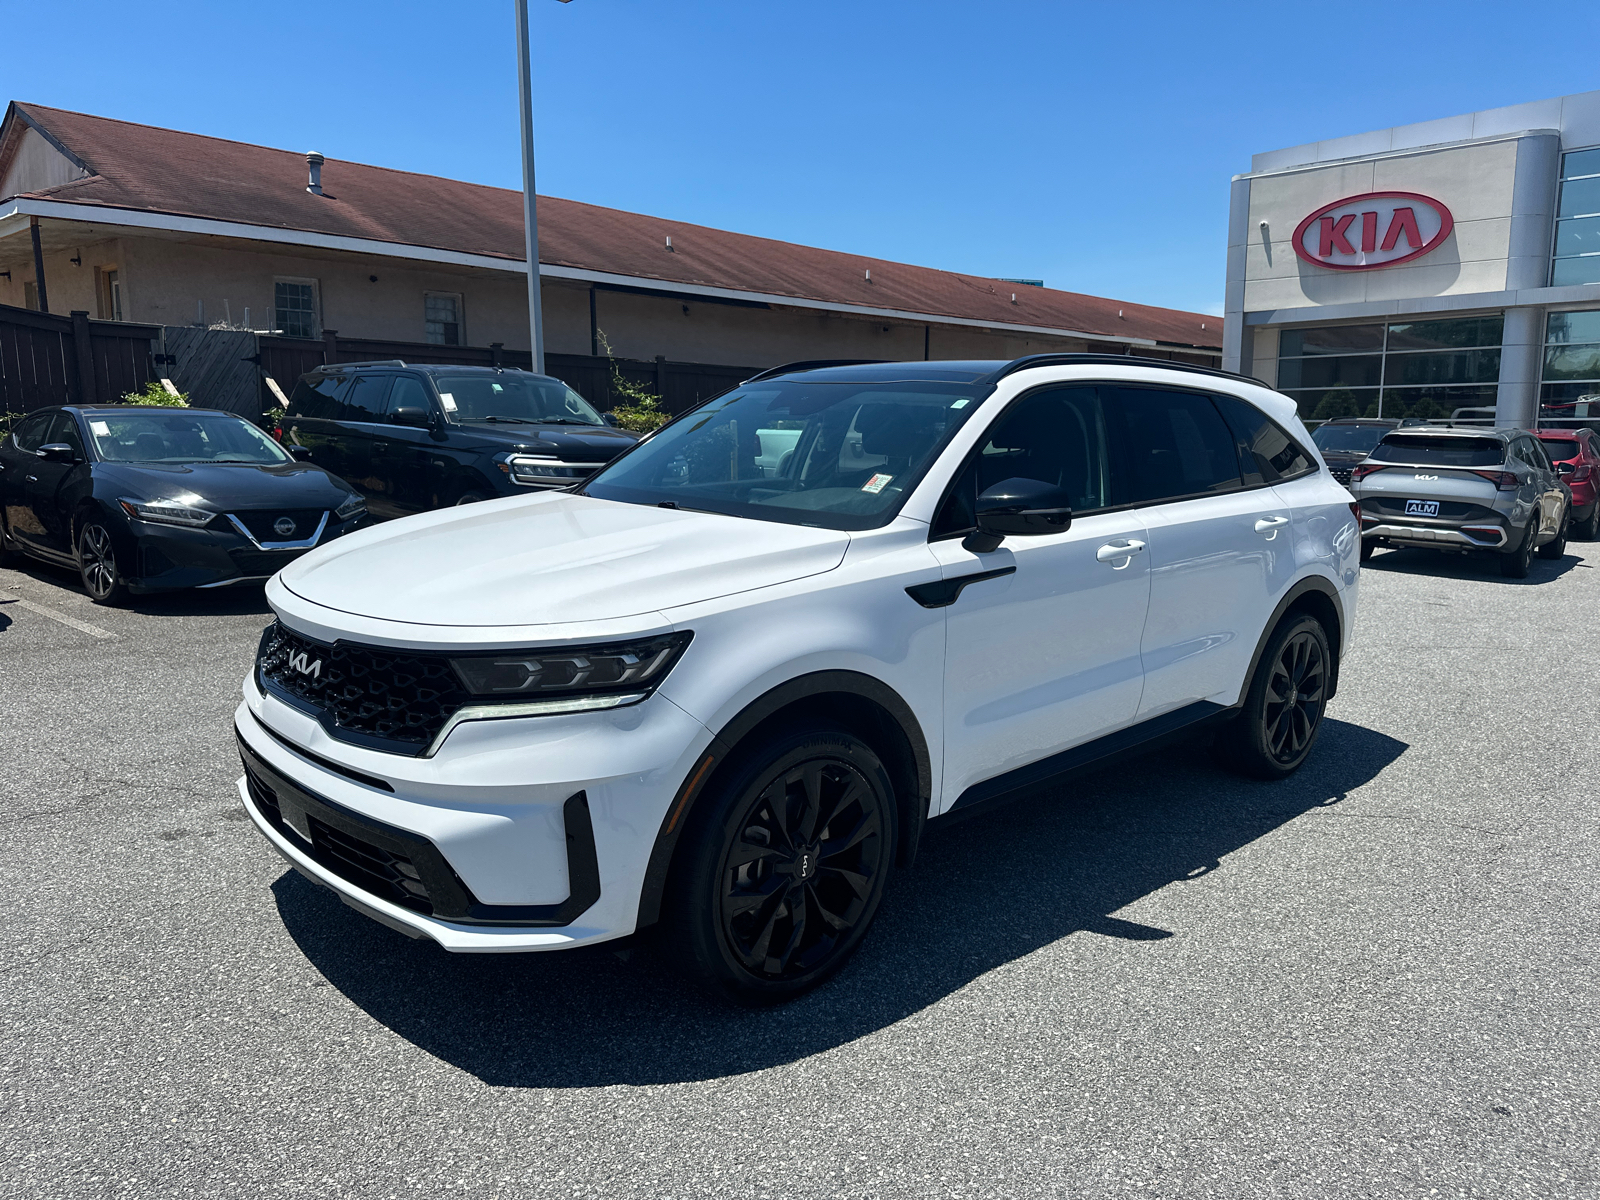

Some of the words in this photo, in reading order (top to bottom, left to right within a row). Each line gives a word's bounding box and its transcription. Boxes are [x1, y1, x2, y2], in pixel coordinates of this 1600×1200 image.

[1319, 207, 1423, 257] KIA
[1409, 504, 1435, 513] ALM
[289, 649, 321, 679] KIA
